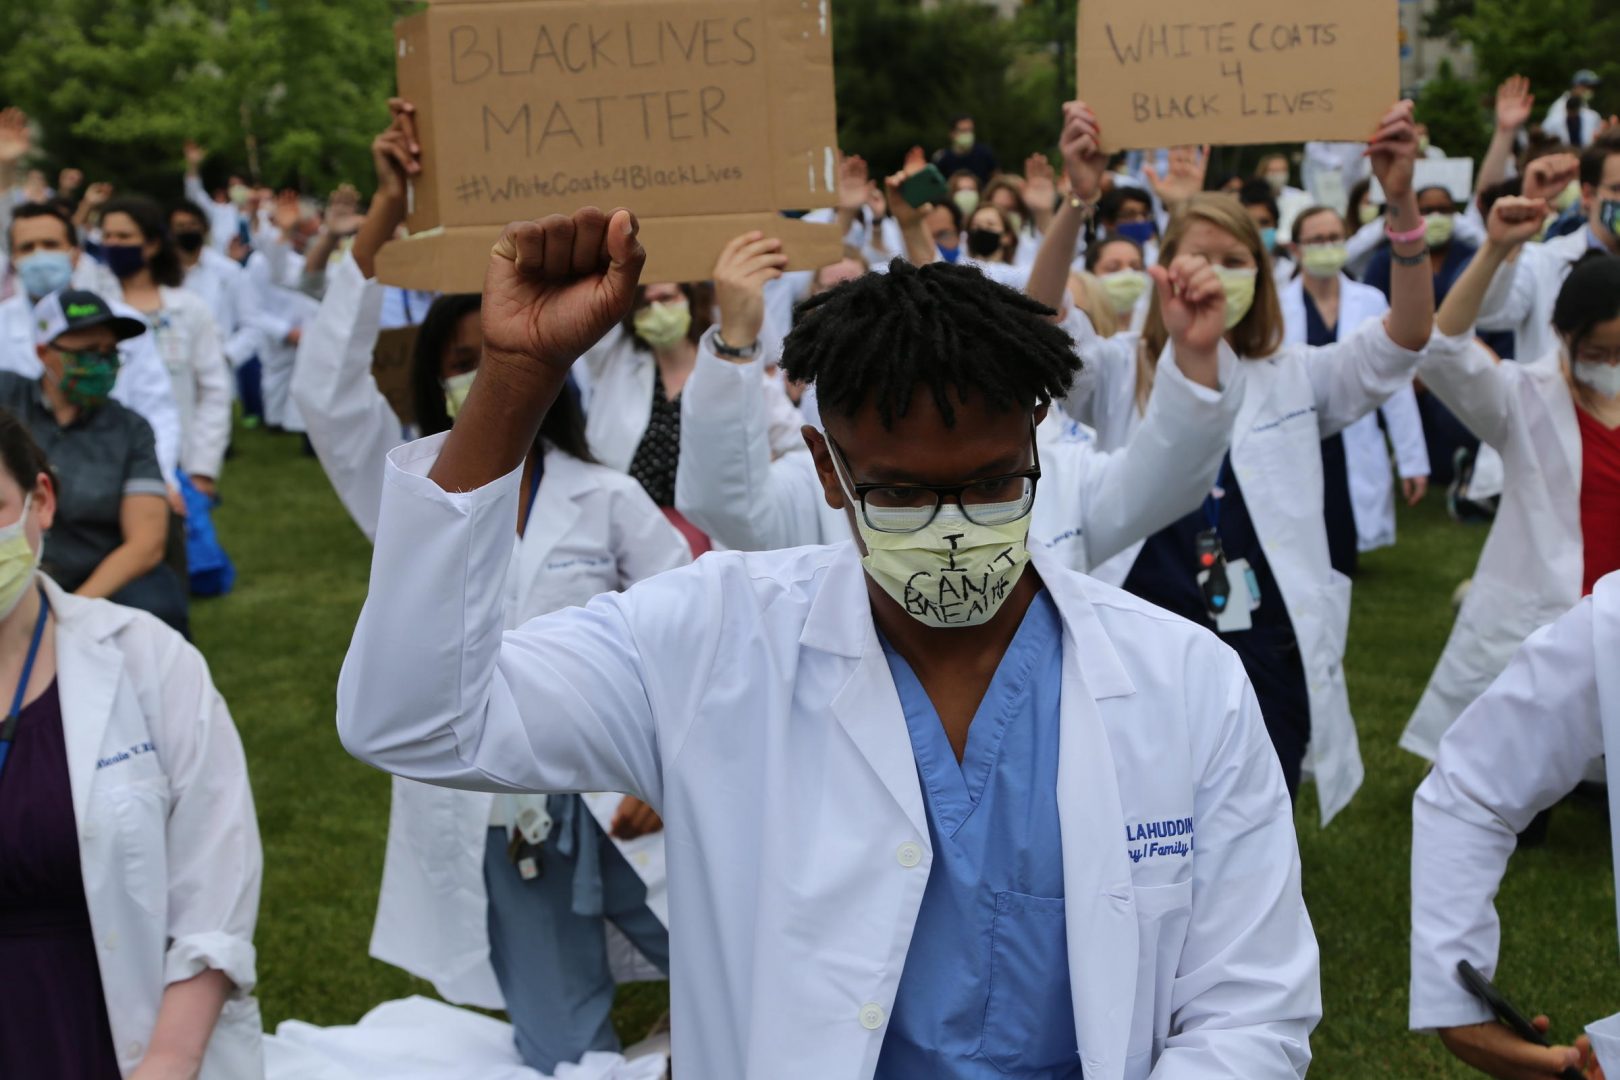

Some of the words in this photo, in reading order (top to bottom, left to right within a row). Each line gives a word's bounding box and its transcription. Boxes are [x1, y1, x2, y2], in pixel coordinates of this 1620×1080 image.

[625, 17, 756, 69] LIVES
[1105, 22, 1236, 65] WHITE
[1249, 22, 1339, 52] COATS
[1220, 61, 1245, 87] 4
[482, 85, 731, 157] MATTER
[1131, 91, 1219, 123] BLACK
[1241, 88, 1335, 116] LIVES
[456, 163, 743, 204] #WhiteCoats4BlackLives
[941, 533, 968, 572] I
[907, 547, 1016, 605] CAN'T
[1149, 841, 1188, 857] Family
